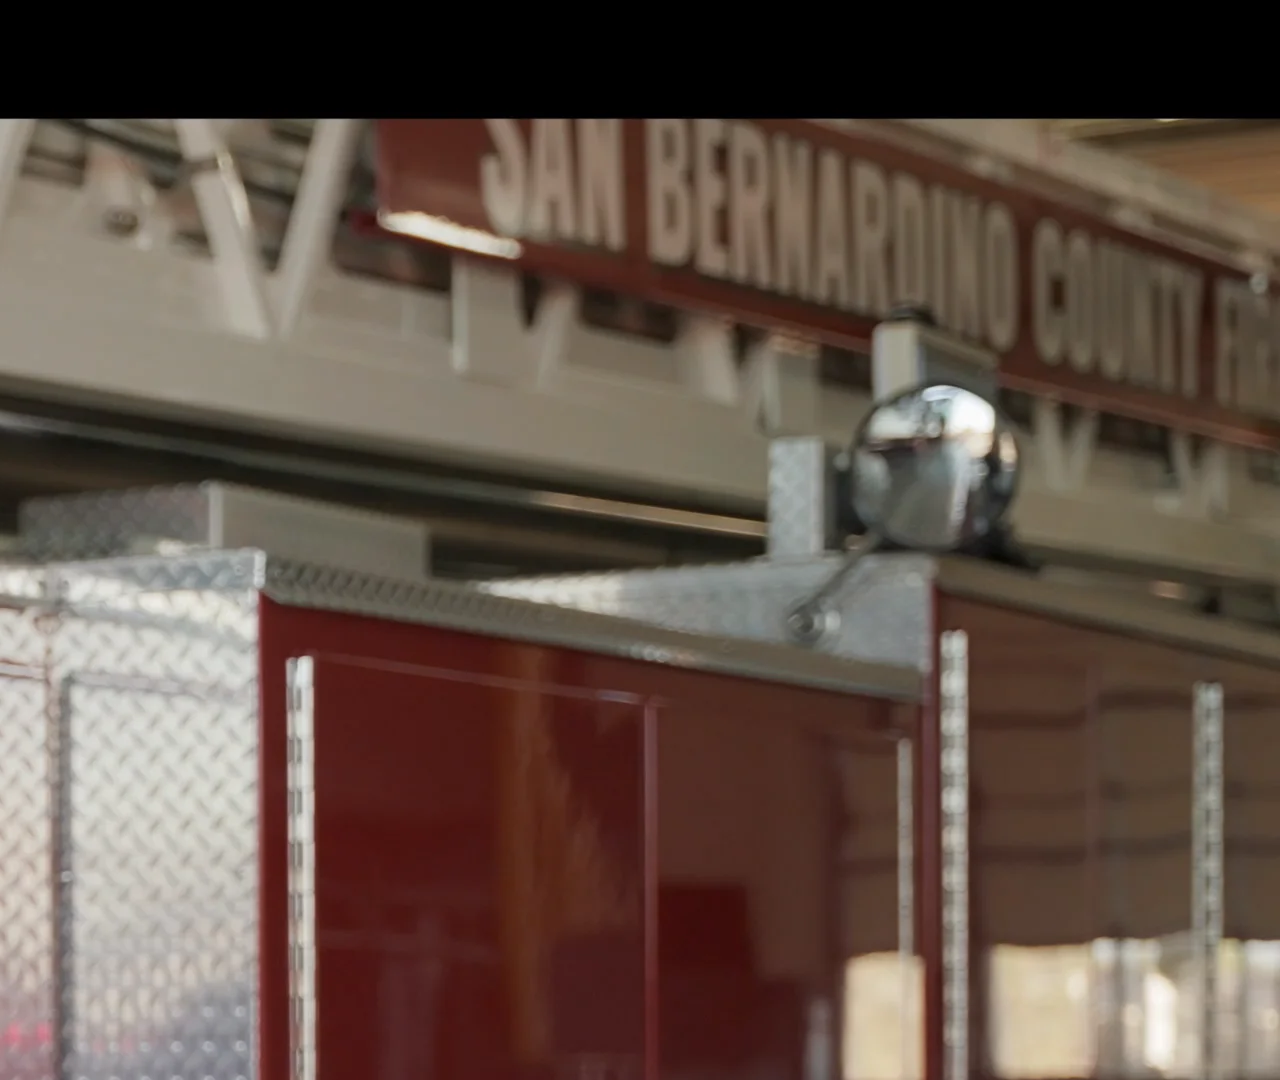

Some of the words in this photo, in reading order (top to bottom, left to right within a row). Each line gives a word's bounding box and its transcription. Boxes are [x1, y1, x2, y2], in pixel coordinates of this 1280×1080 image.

[481, 118, 624, 250] SAN
[645, 118, 1019, 352] BERNARDINO
[1031, 215, 1203, 400] COUNTY
